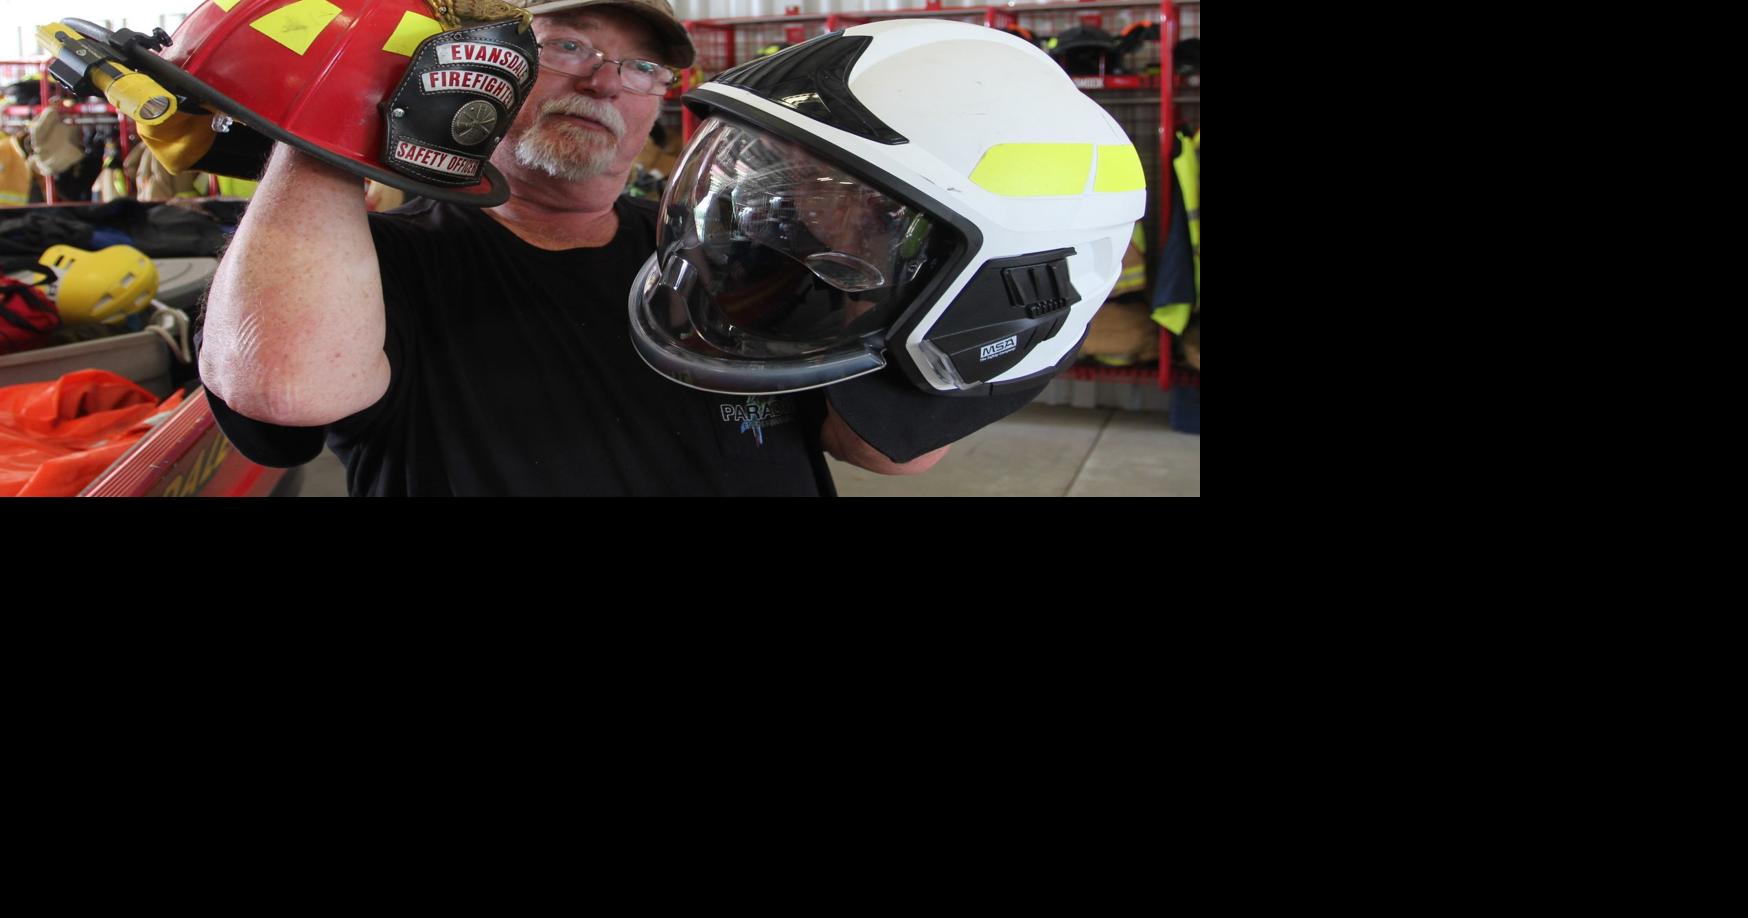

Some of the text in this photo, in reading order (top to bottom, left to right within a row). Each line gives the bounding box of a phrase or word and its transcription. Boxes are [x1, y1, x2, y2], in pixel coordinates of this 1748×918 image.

[429, 71, 513, 107] FIREFIGHTE
[396, 142, 447, 168] SAFETY
[982, 338, 1015, 356] MSA
